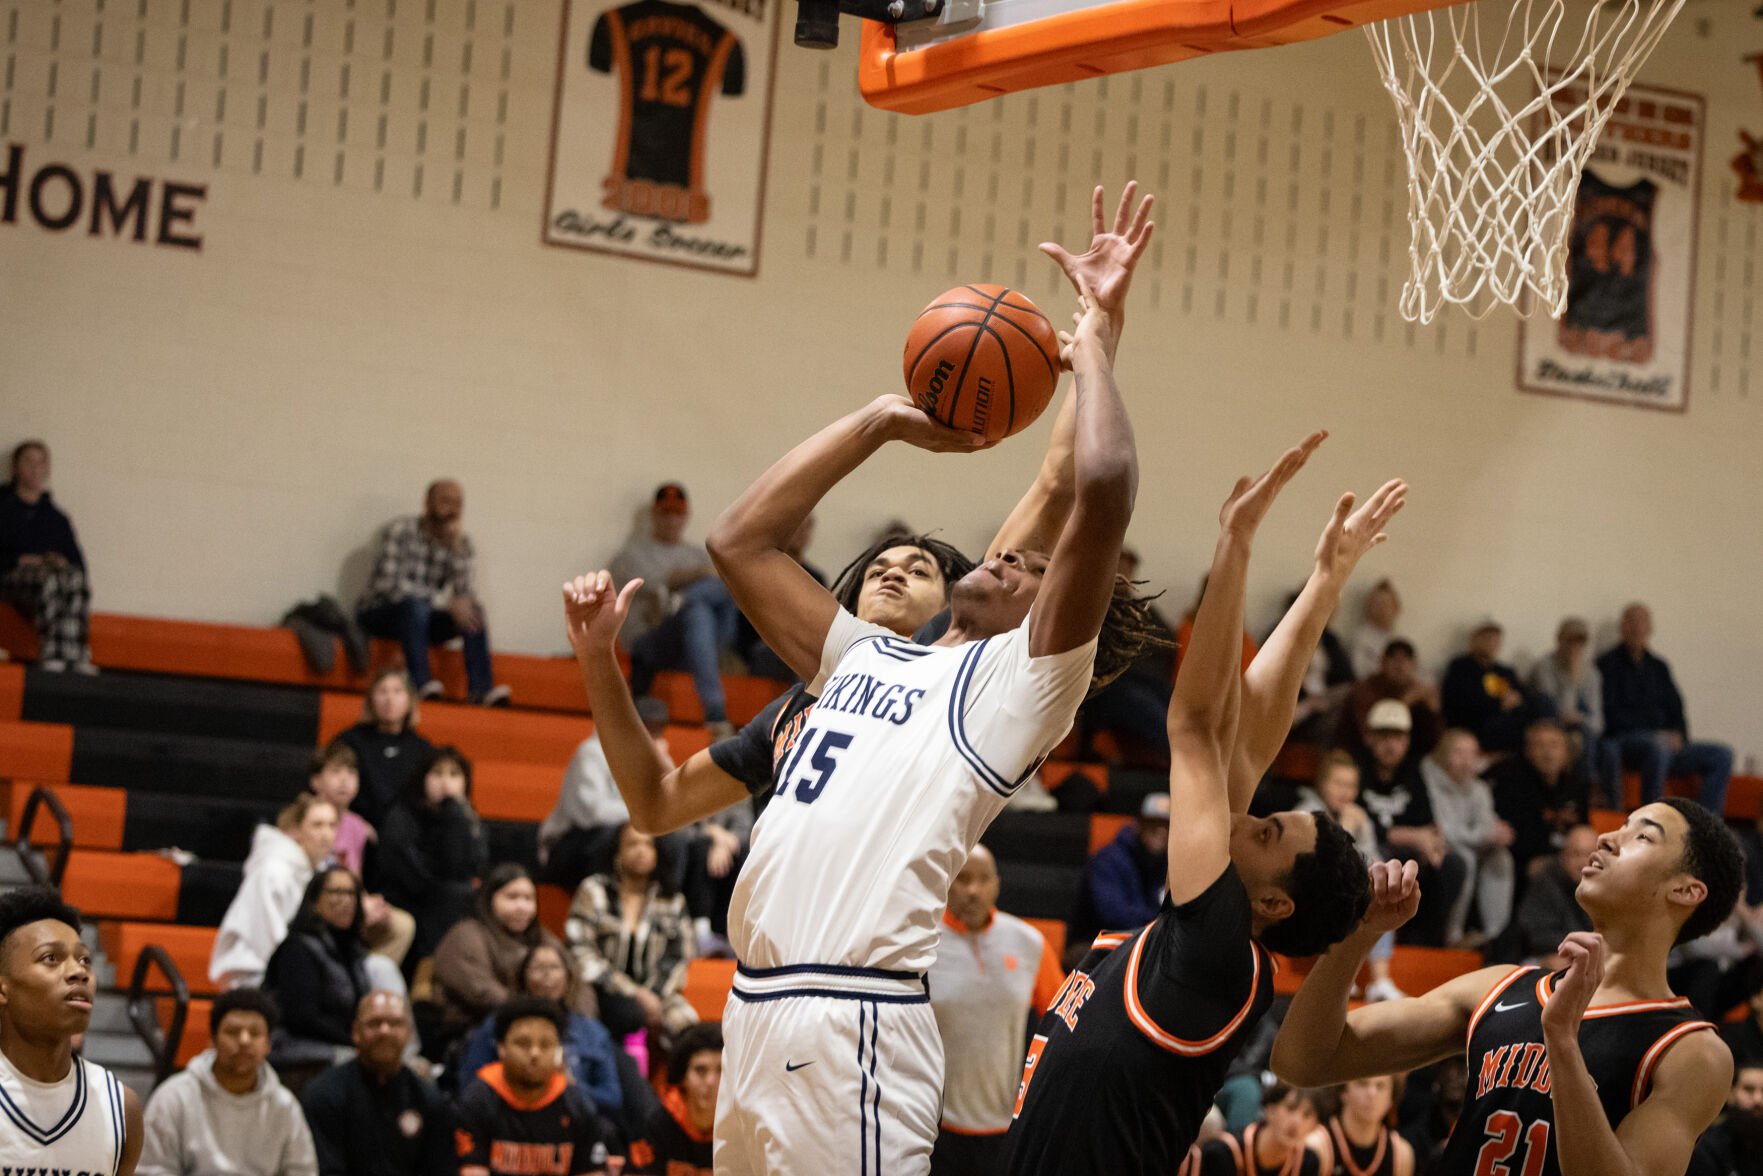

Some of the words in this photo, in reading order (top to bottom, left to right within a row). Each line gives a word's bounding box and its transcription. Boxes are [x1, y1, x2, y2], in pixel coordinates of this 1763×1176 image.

[640, 45, 694, 106] 12
[917, 359, 956, 417] lson
[775, 727, 855, 805] 15
[1472, 1109, 1551, 1176] 21
